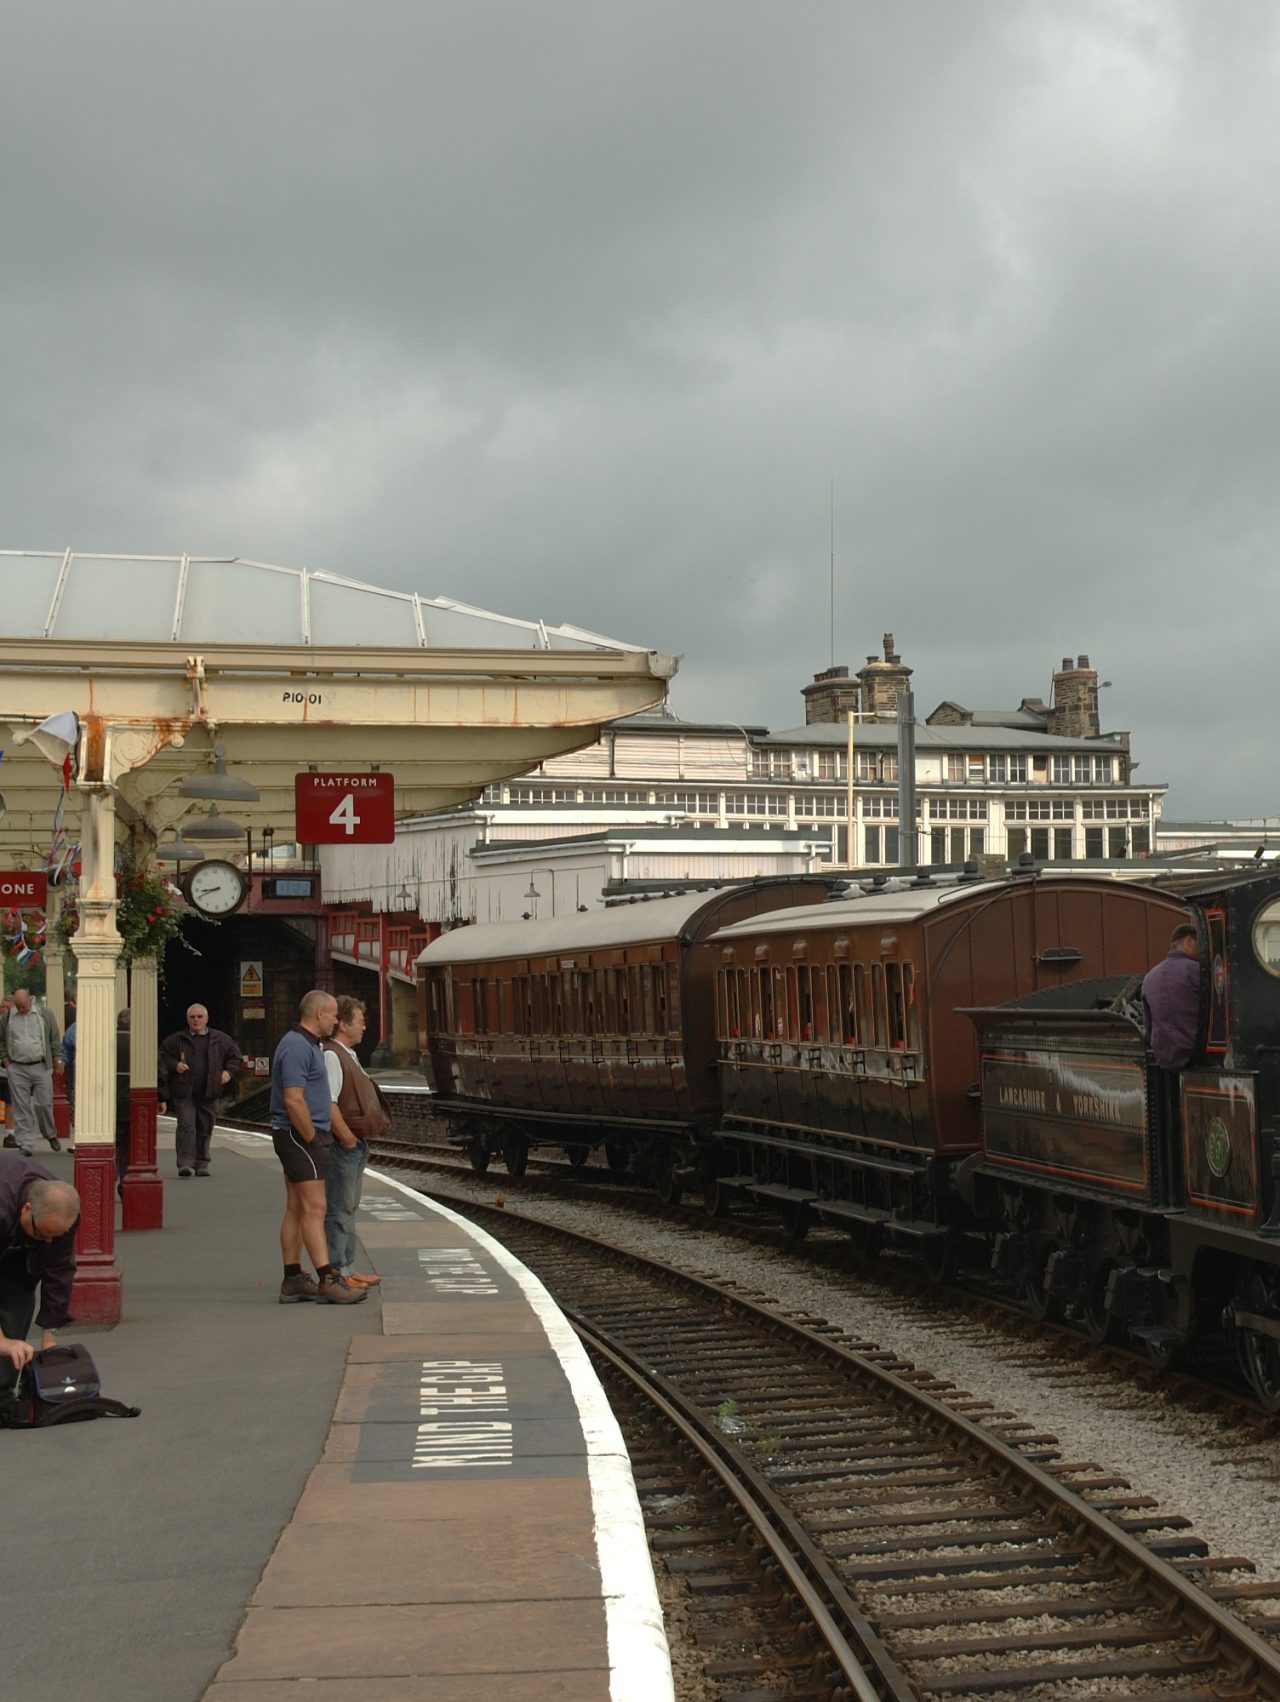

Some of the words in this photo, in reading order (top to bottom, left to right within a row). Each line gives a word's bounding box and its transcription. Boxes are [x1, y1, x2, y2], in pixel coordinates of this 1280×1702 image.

[314, 778, 377, 787] PLATFORM
[329, 793, 361, 835] 4
[1, 883, 34, 895] ONE
[999, 1087, 1046, 1112] LANCASHIRE
[1072, 1094, 1120, 1121] YORKSHIRE
[420, 1360, 504, 1383] GAP
[420, 1386, 509, 1415] THE
[412, 1421, 513, 1468] MIND
